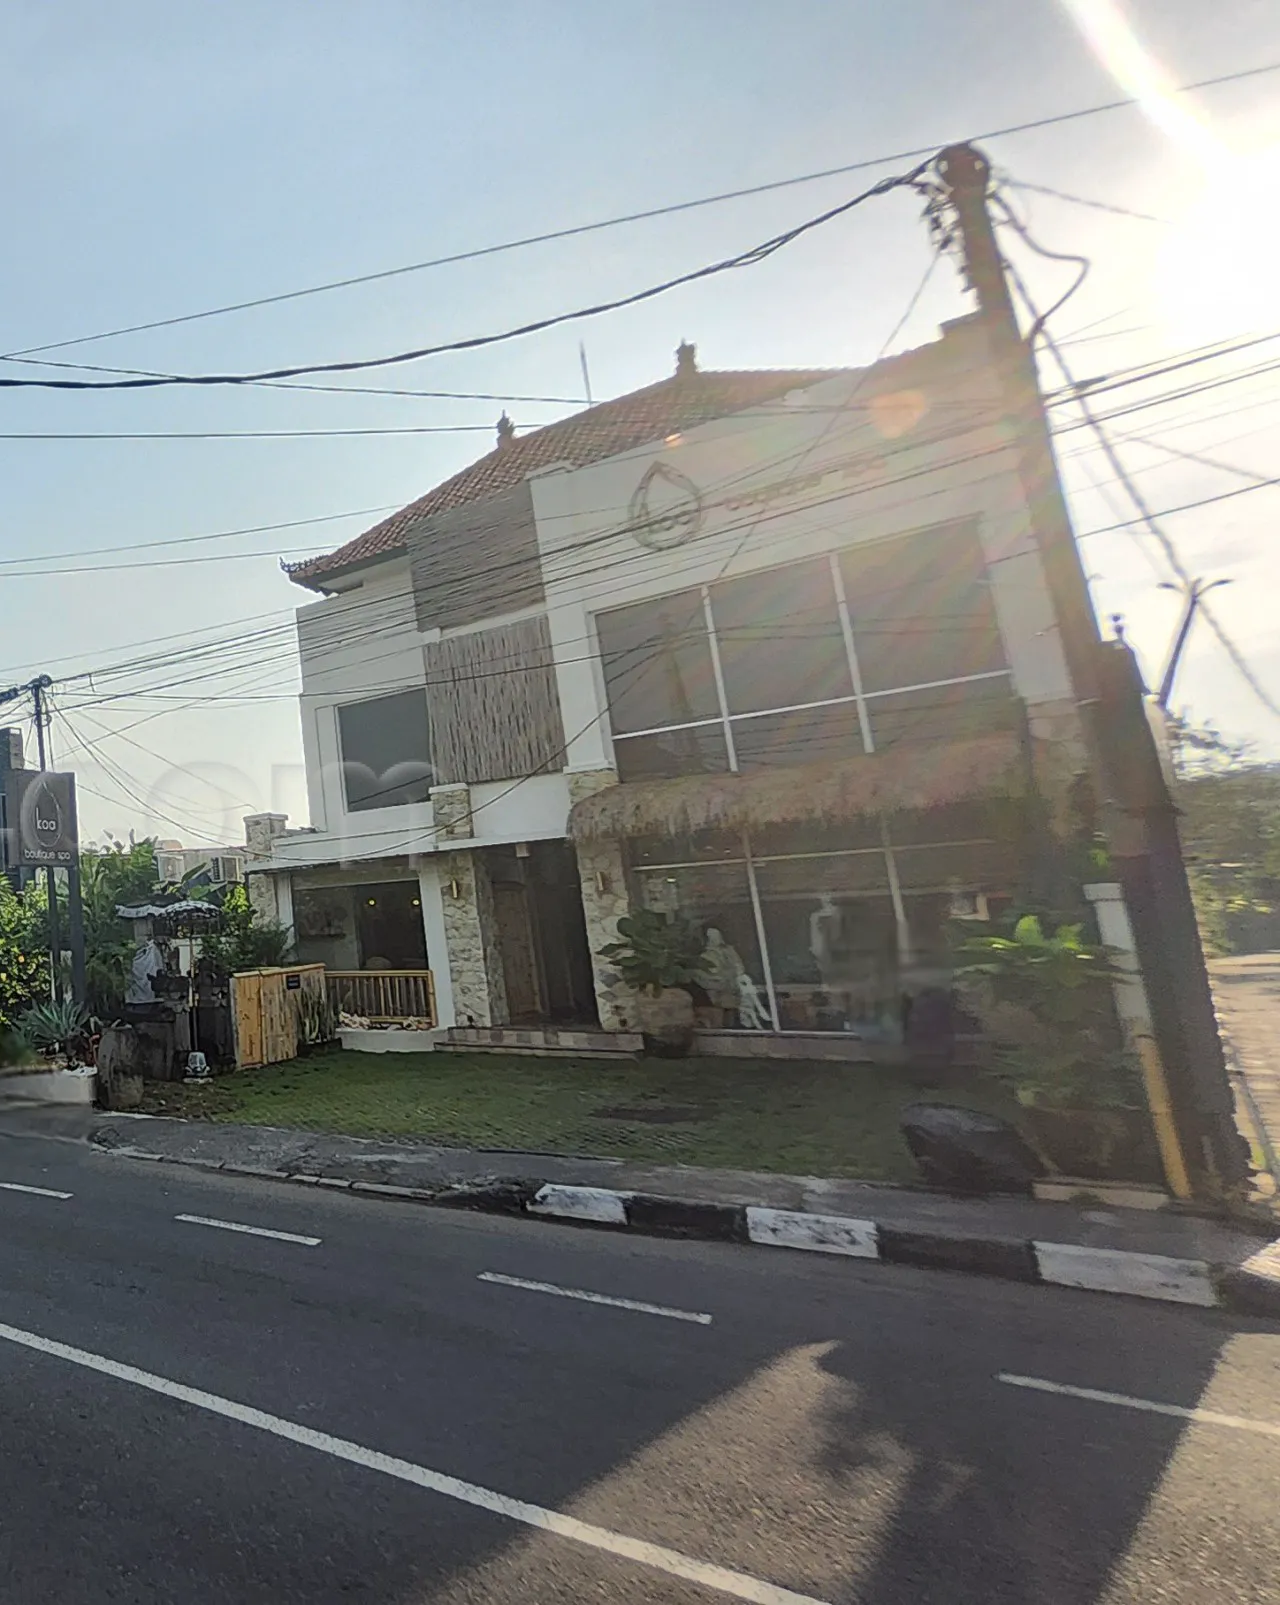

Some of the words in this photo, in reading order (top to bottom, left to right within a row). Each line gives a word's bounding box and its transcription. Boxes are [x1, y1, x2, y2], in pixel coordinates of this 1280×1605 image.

[35, 807, 57, 830] koa
[23, 848, 56, 860] boutique
[57, 850, 71, 860] spa
